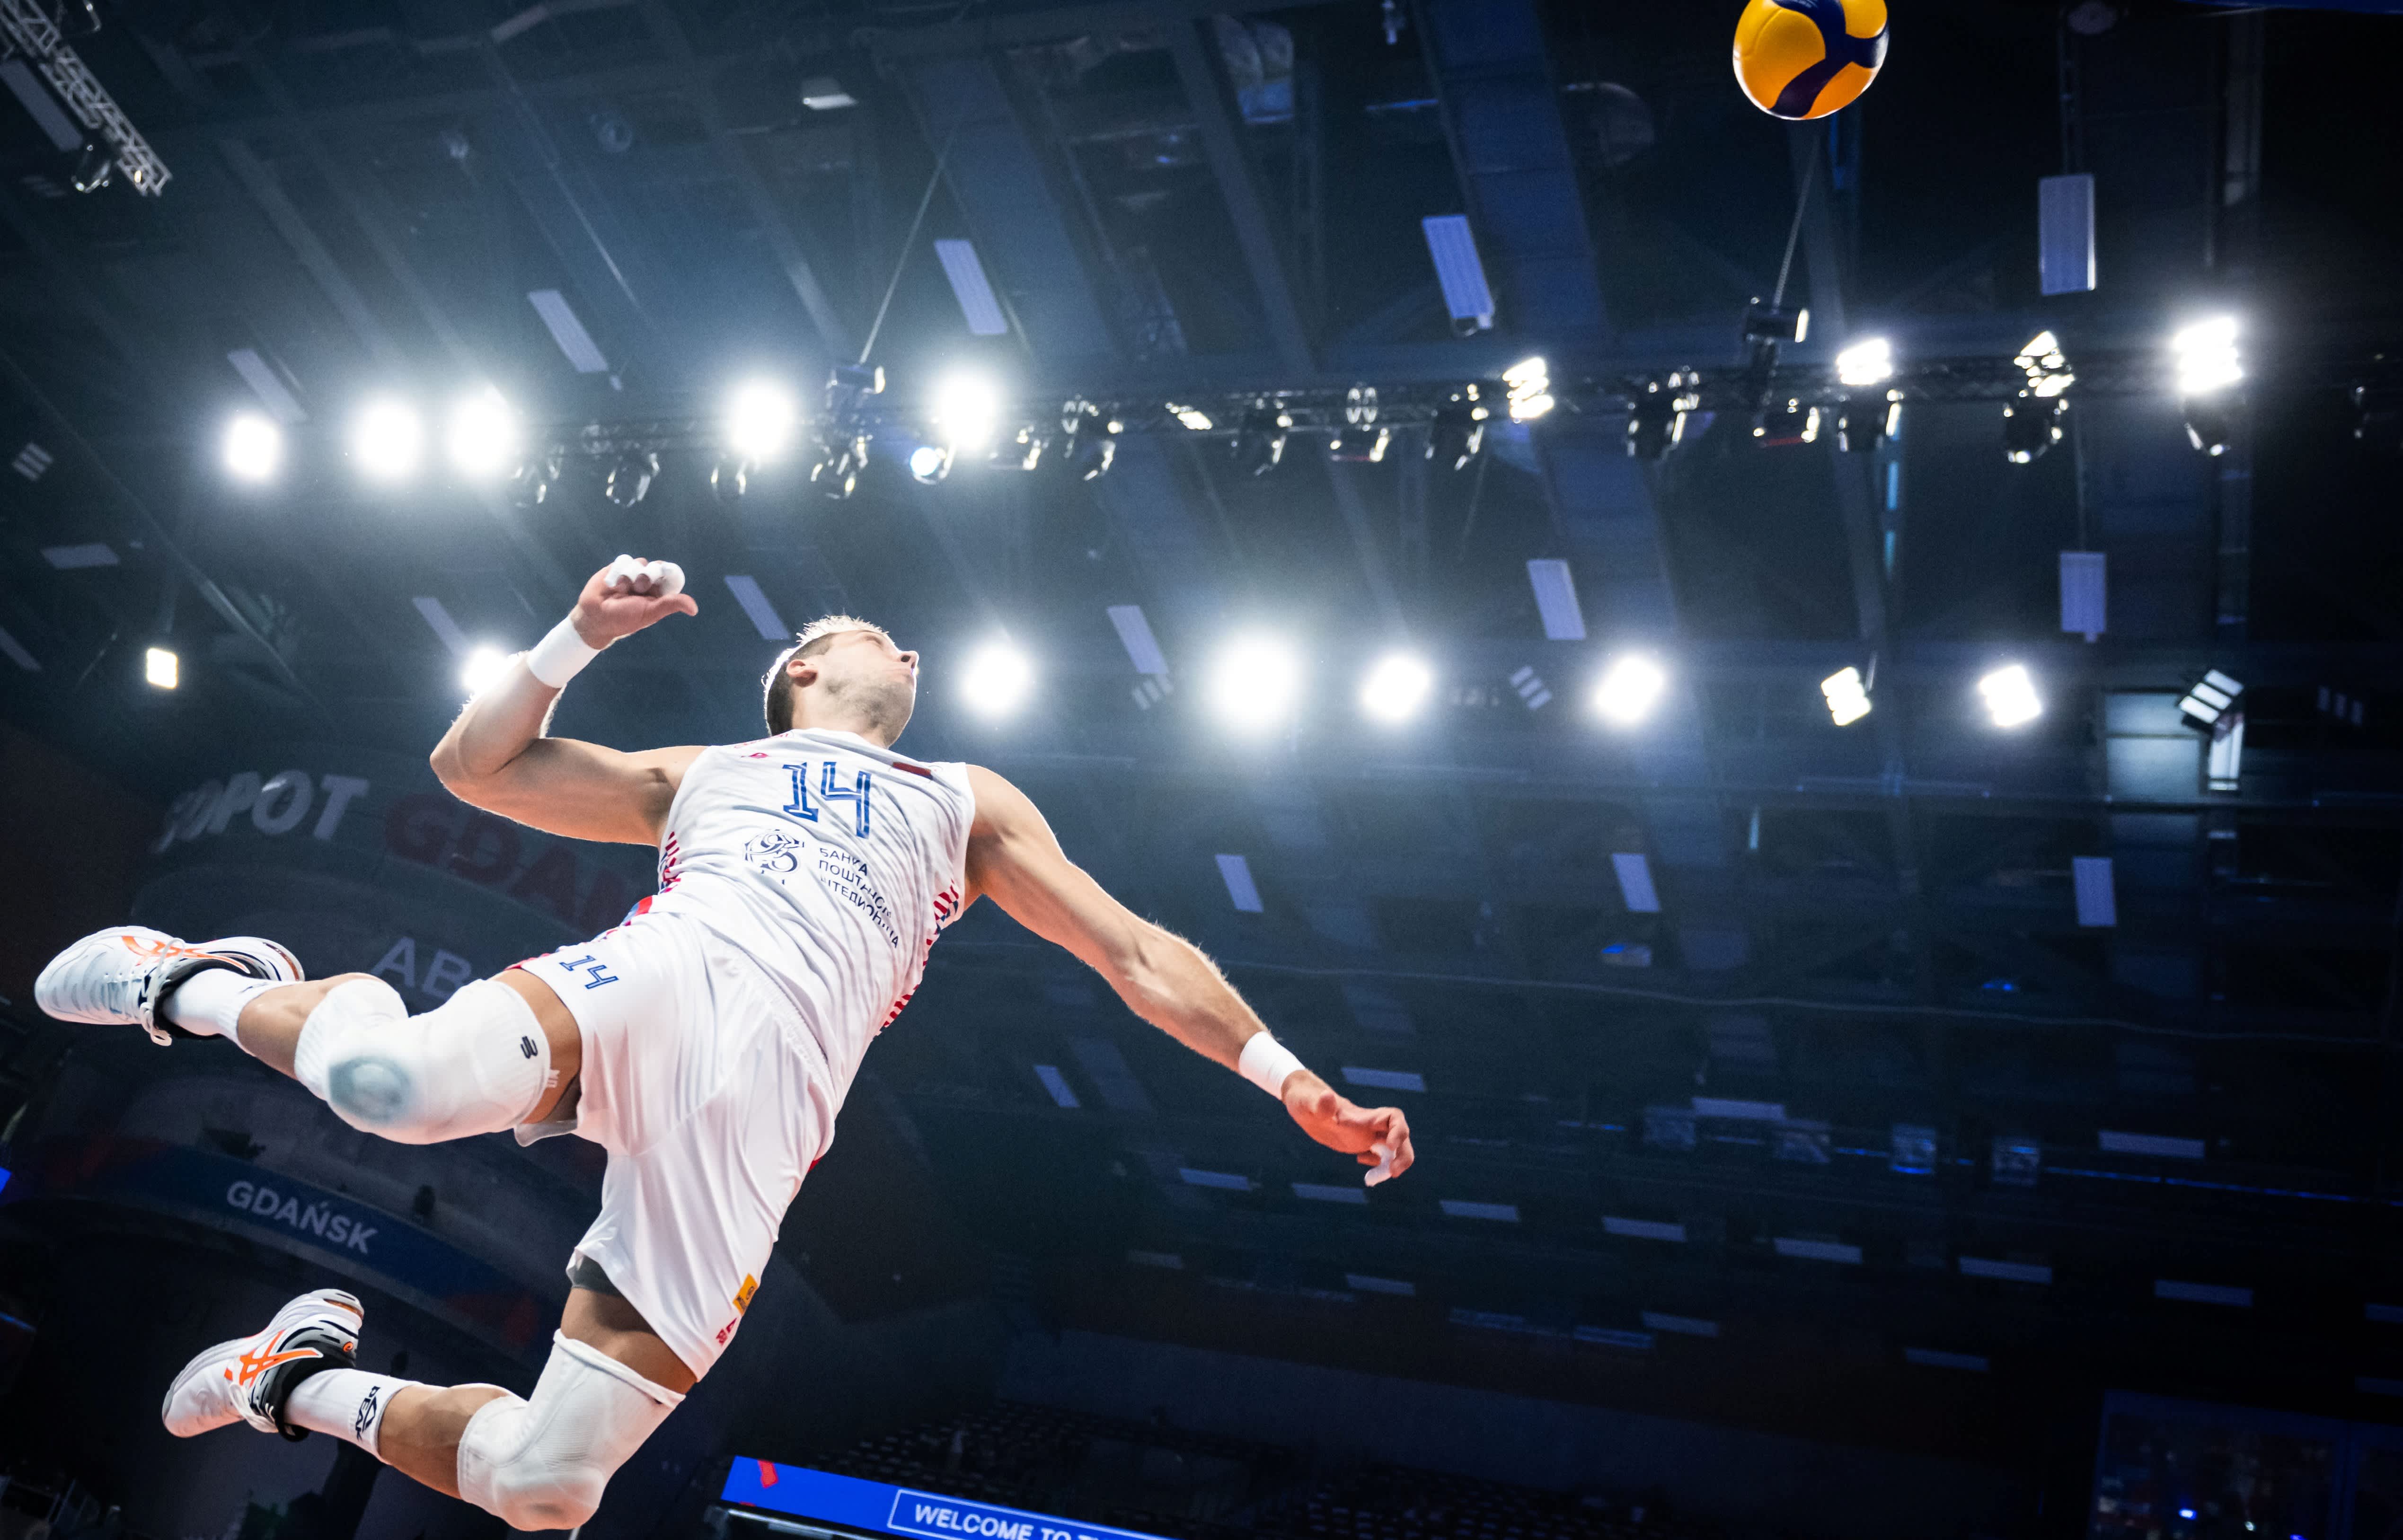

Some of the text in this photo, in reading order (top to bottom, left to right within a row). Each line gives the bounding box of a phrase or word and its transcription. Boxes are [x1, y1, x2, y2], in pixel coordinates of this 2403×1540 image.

[782, 761, 871, 839] 14
[559, 955, 619, 989] 14
[225, 1180, 379, 1254] GDAŃSK
[915, 1504, 1034, 1540] WELCOME
